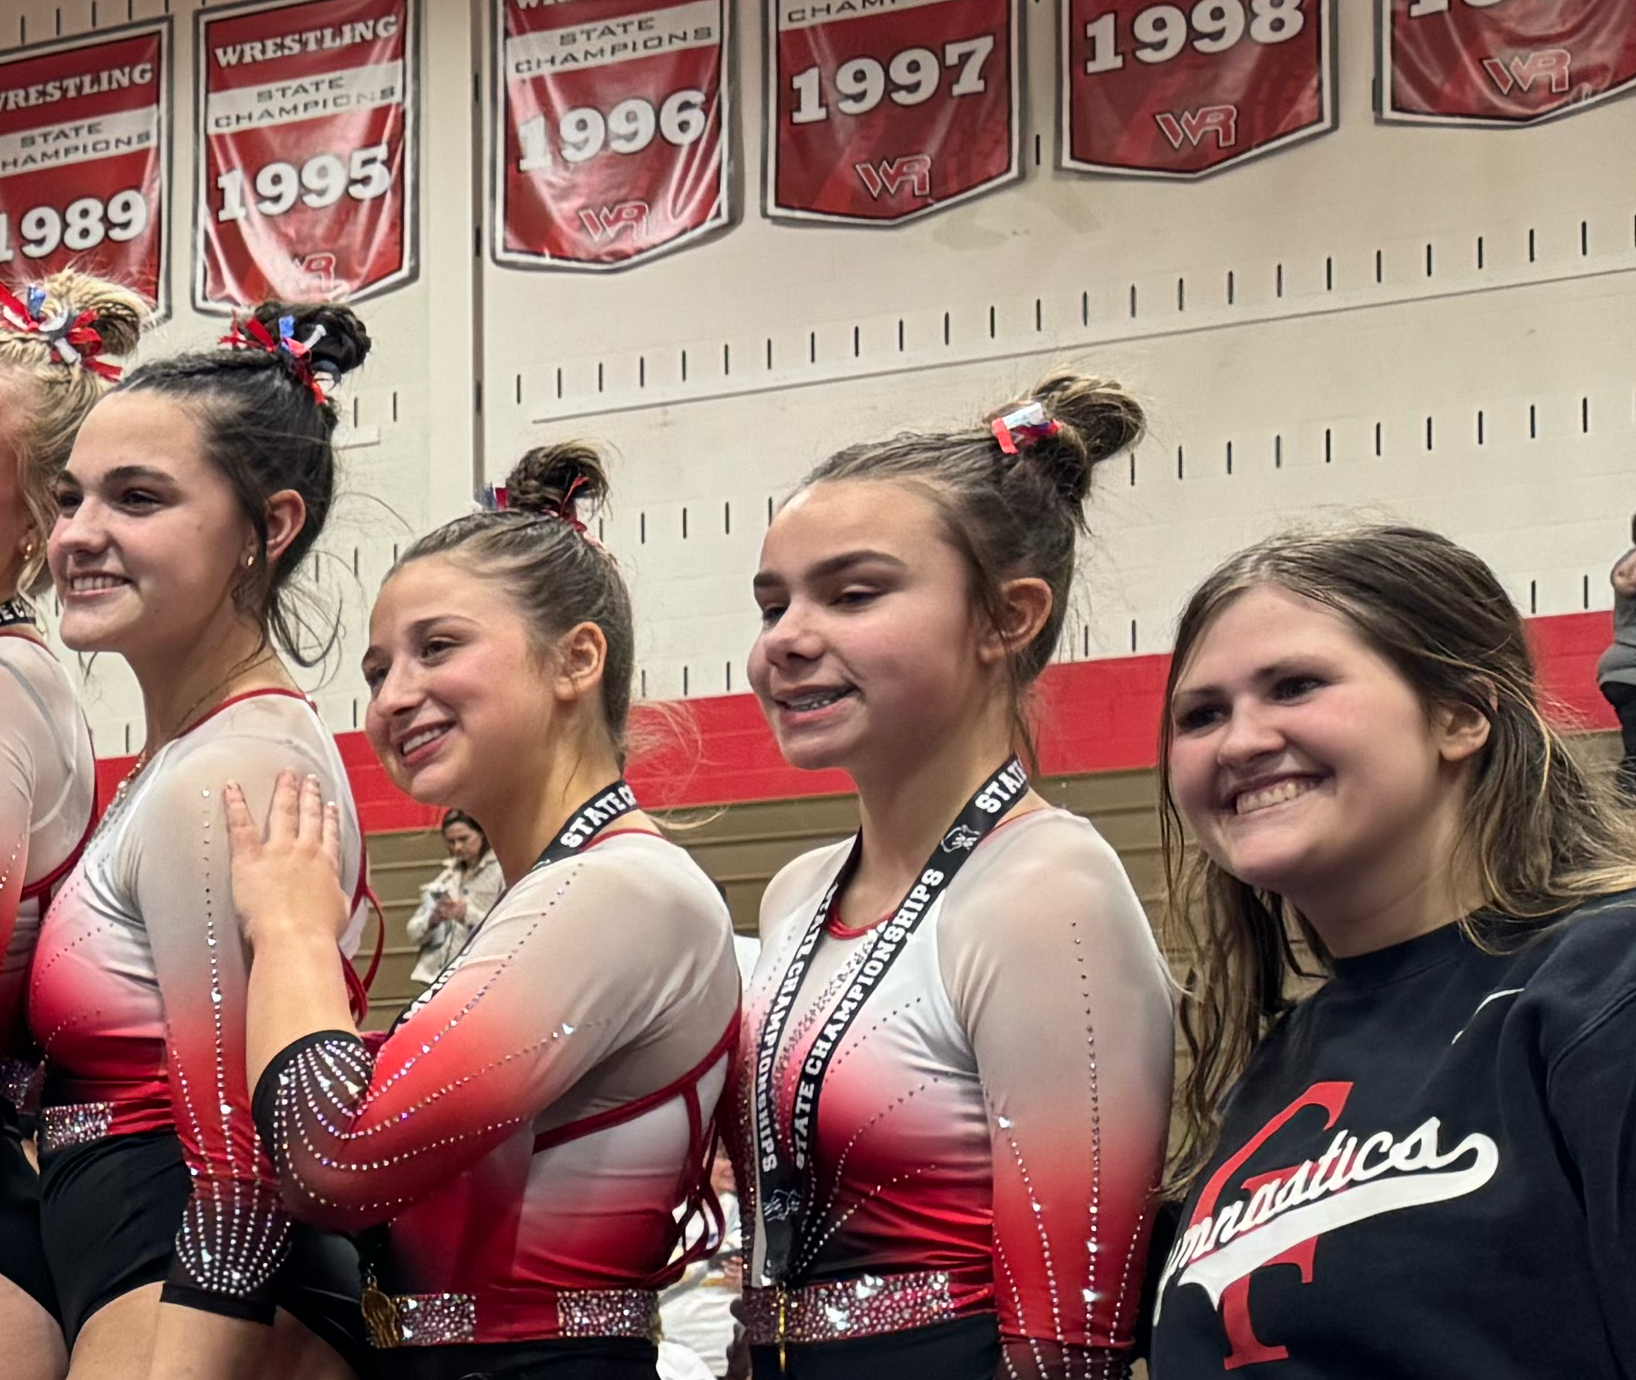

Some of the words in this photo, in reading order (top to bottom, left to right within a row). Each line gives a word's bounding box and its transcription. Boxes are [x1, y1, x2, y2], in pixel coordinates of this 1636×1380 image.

[214, 14, 399, 69] WRESTLING
[514, 26, 714, 75] CHAMPIONS
[560, 16, 655, 47] STATE
[1084, 0, 1305, 75] 1998
[214, 85, 396, 129] CHAMPIONS
[257, 75, 345, 103] STATE
[790, 34, 996, 126] 1997
[20, 121, 104, 149] STATE
[517, 88, 707, 173] 1996
[217, 142, 392, 224] 1995
[559, 785, 624, 850] STATE
[803, 866, 946, 1075] CHAMPIONSHIPS
[756, 960, 804, 1173] CHAMPIONSHIPS
[794, 1070, 816, 1170] STATE
